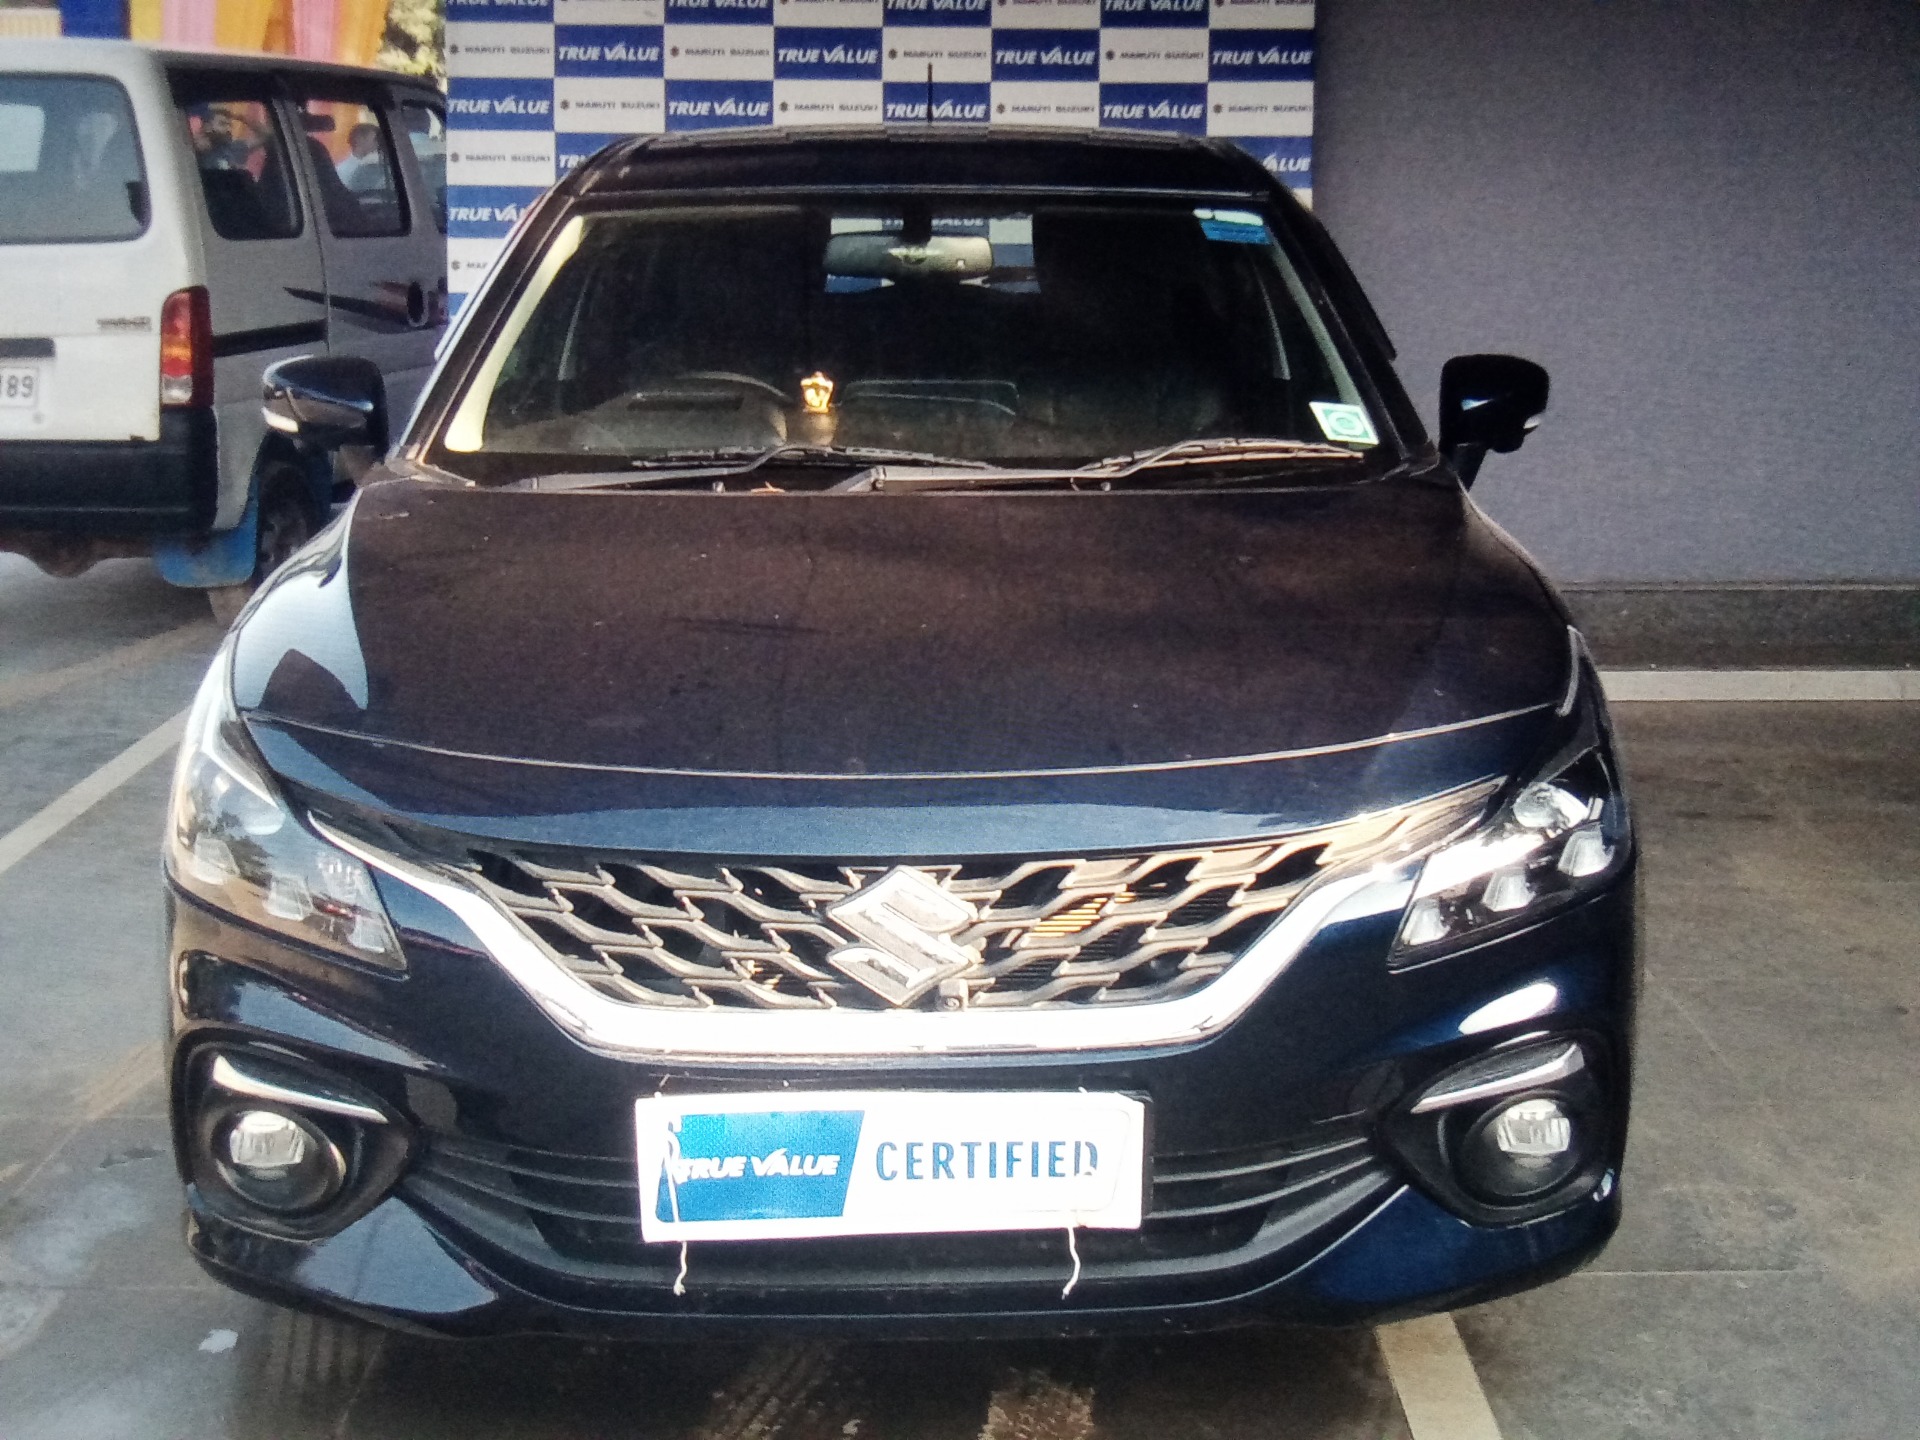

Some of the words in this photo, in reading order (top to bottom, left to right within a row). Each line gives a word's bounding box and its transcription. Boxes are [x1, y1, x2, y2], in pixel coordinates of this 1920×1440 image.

[559, 46, 600, 61] TRUE
[604, 42, 660, 61] VALUE
[778, 48, 818, 63] TRUE
[823, 44, 878, 63] VALUE
[995, 50, 1037, 65] TRUE
[1041, 45, 1096, 65] VALUE
[1212, 50, 1253, 65] TRUE
[1257, 45, 1313, 65] VALUE
[449, 99, 491, 114] TRUE
[494, 95, 549, 114] VALUE
[668, 101, 709, 116] TRUE
[713, 97, 769, 116] VALUE
[886, 103, 927, 118] TRUE
[931, 99, 986, 118] VALUE
[1103, 103, 1145, 118] TRUE
[1148, 99, 1204, 118] VALUE
[449, 207, 492, 221] TRUE
[0, 374, 34, 398] 89
[677, 1155, 747, 1180] TRUE
[750, 1148, 841, 1177] VALUE
[875, 1140, 1099, 1181] CERTIFIED
